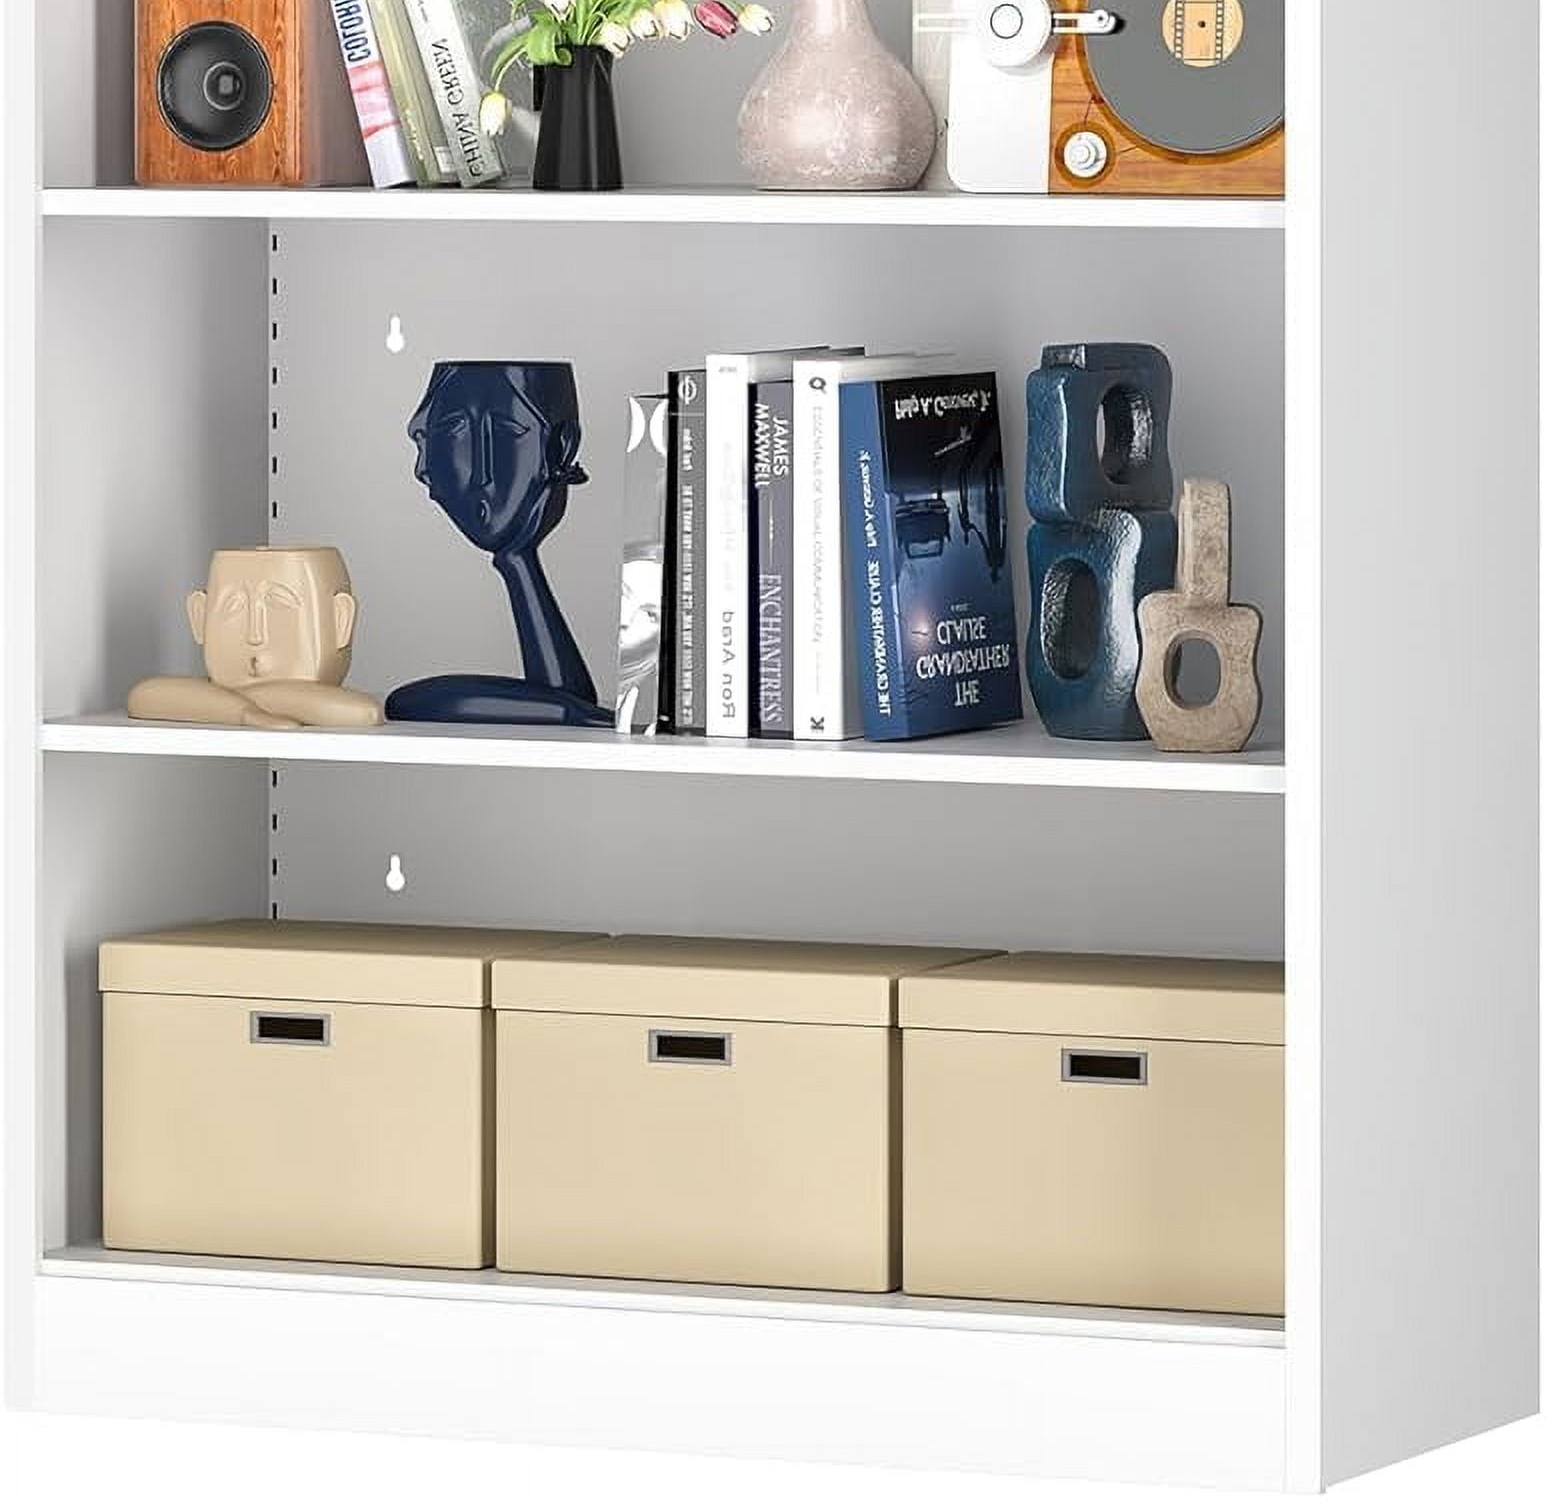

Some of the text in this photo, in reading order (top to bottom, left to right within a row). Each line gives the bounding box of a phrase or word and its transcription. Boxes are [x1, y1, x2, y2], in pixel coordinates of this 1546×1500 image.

[754, 403, 771, 488] MAXWELL
[772, 417, 789, 477] JAMES
[759, 574, 784, 723] ENCHANTRESS
